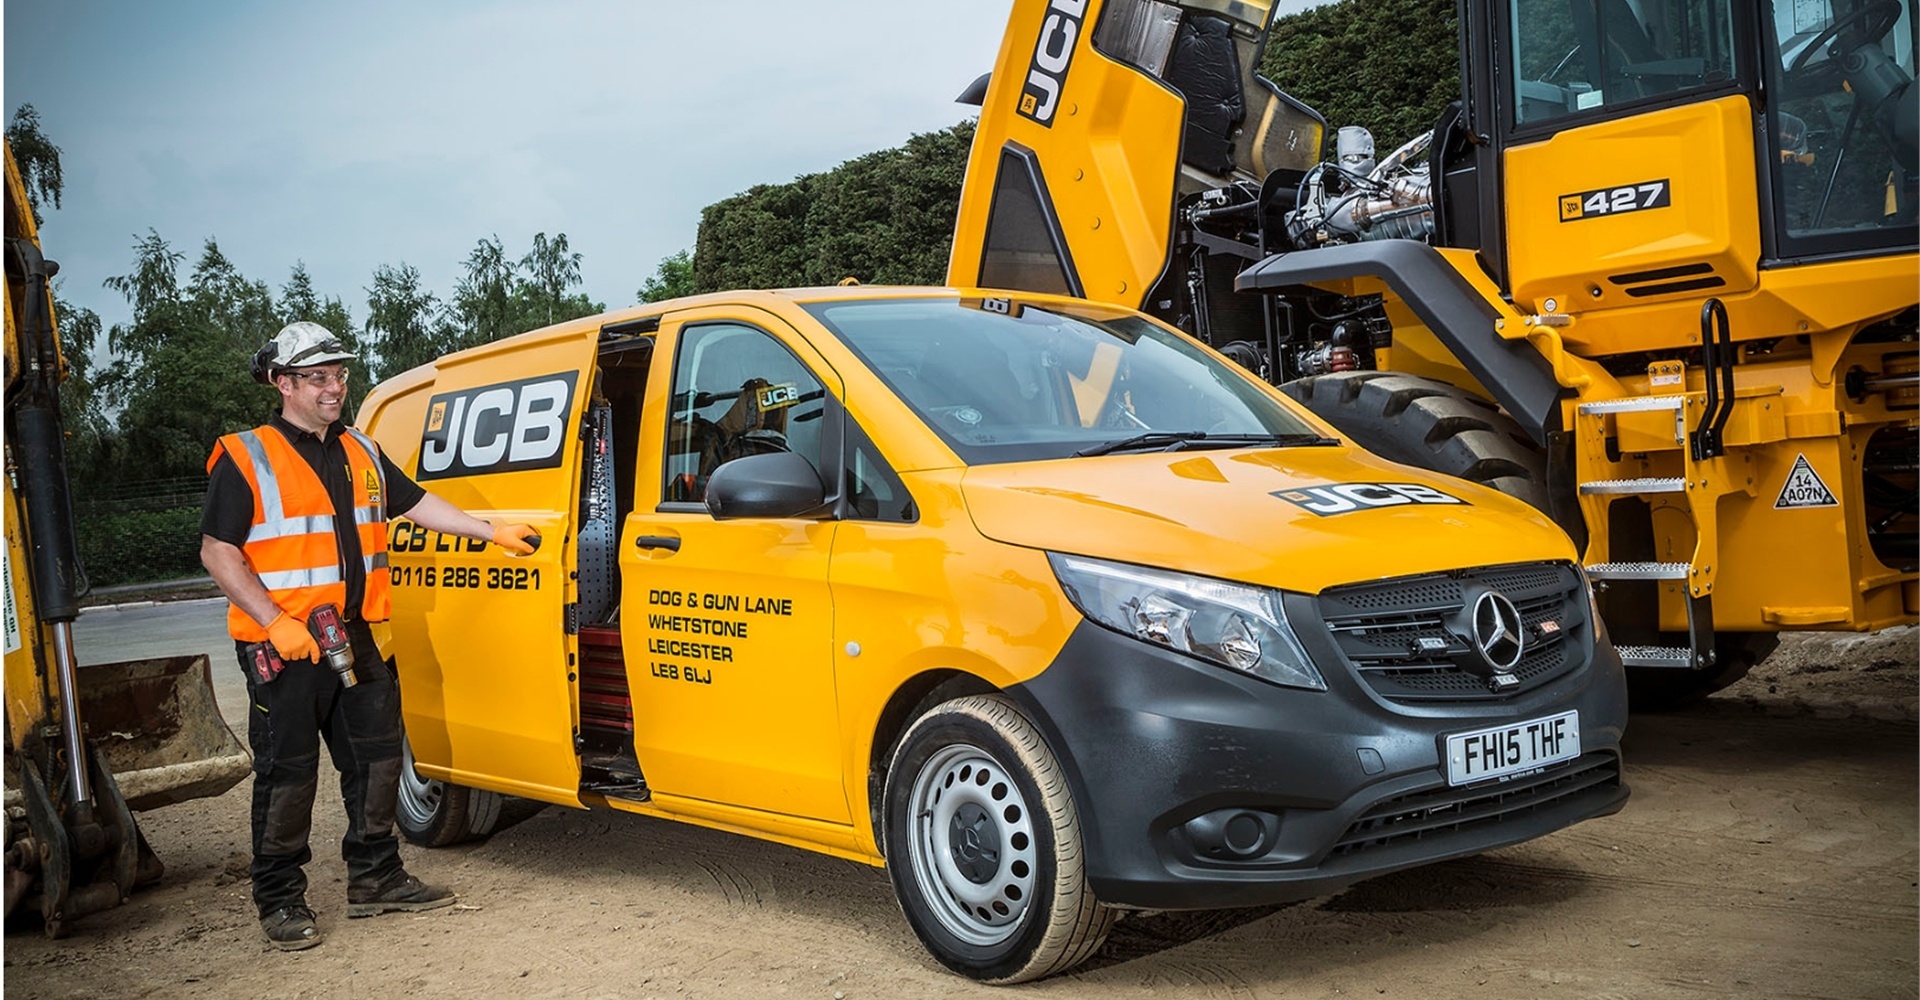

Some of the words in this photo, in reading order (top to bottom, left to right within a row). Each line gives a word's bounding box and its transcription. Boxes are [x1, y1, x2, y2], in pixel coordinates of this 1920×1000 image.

[1583, 182, 1664, 214] 427
[762, 386, 798, 407] JCB
[423, 379, 569, 473] JCB
[1795, 474, 1812, 488] 14
[1304, 483, 1462, 513] JCB
[387, 522, 428, 552] CB
[442, 567, 480, 589] 286
[487, 568, 540, 590] 3621
[649, 589, 682, 607] DOG
[687, 592, 699, 608] &
[703, 593, 740, 612] GUN
[745, 596, 793, 616] LANE
[648, 614, 748, 638] WHETSTONE
[648, 638, 733, 662] LEICESTER
[651, 662, 679, 680] LE8
[683, 666, 712, 685] 6LJ
[1464, 729, 1521, 775] FH15
[1527, 718, 1566, 761] THF
